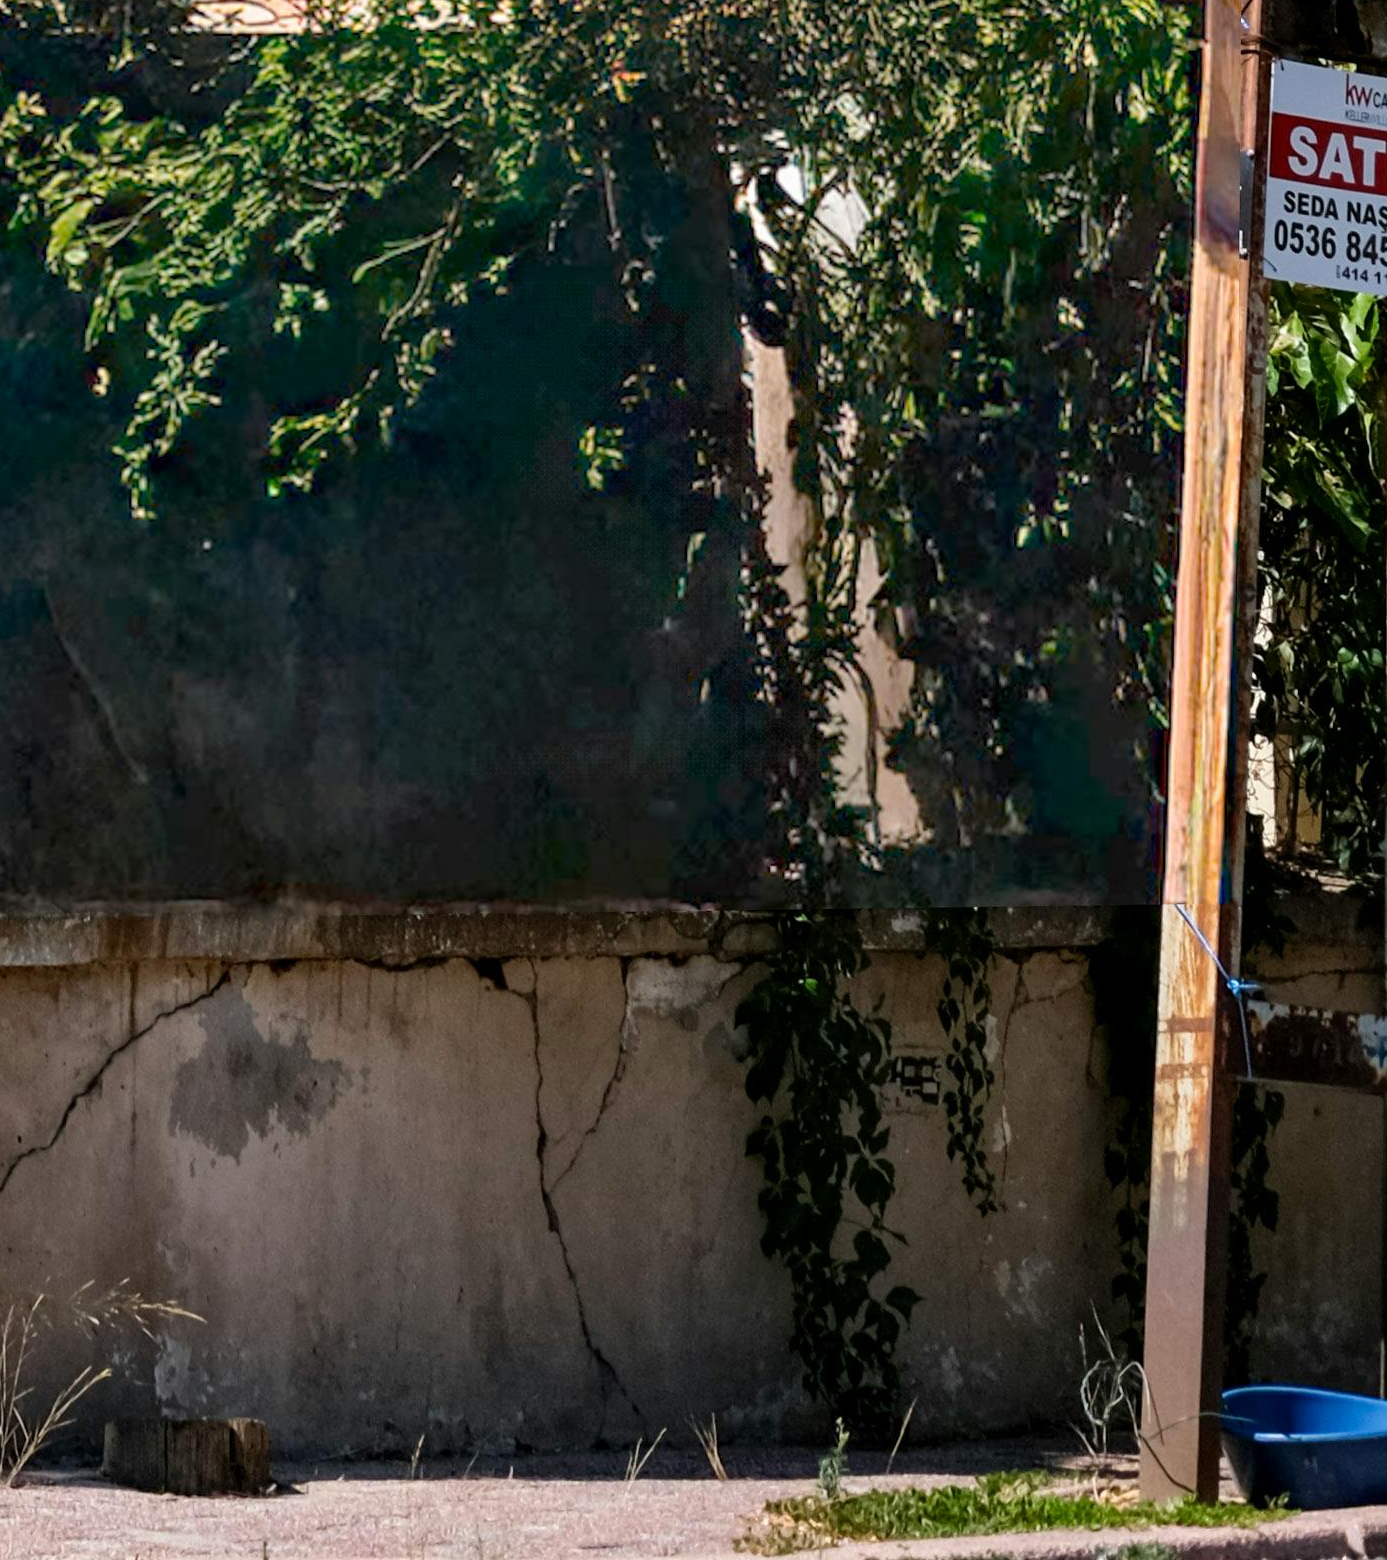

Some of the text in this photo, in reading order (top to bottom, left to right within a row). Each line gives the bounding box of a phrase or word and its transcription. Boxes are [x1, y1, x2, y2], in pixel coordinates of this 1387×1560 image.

[1287, 125, 1386, 187] SAT
[1283, 190, 1339, 220] SEDA
[1274, 219, 1336, 259] 0536
[1342, 266, 1369, 282] 414
